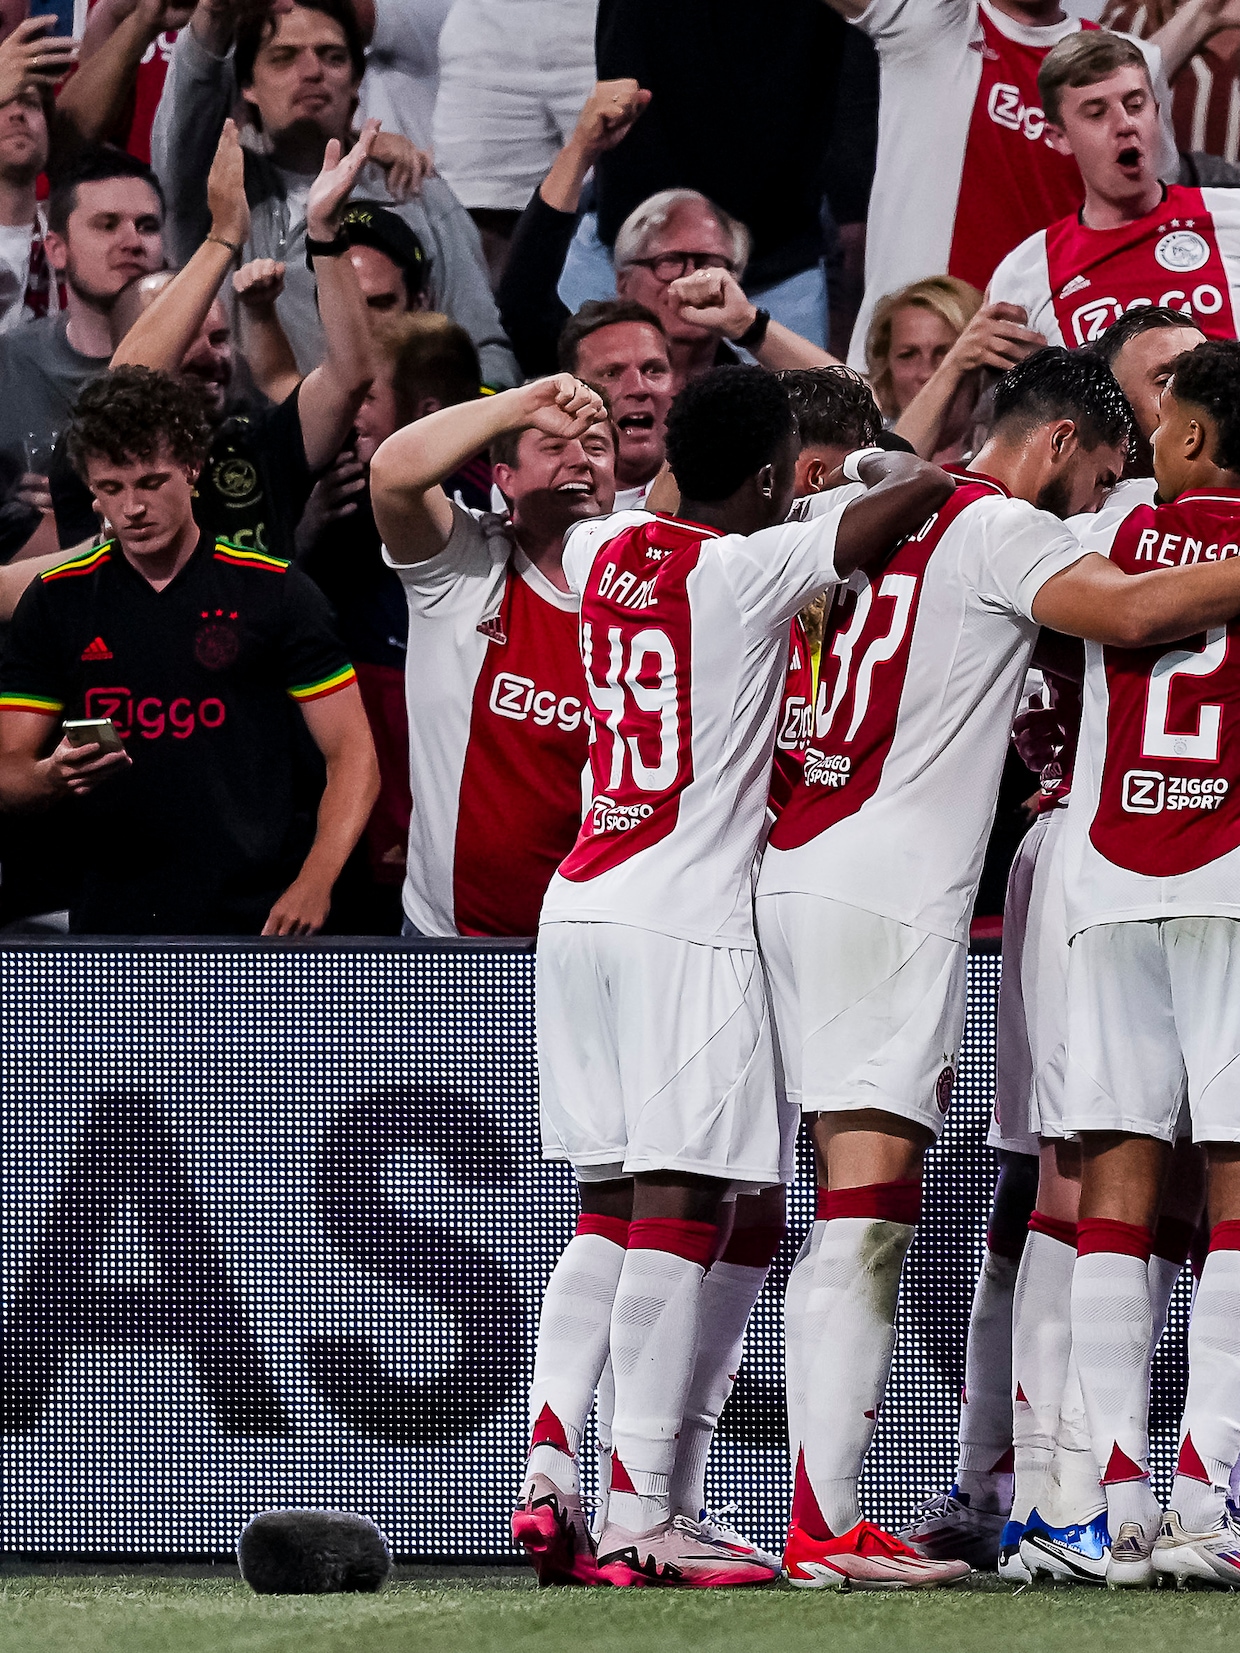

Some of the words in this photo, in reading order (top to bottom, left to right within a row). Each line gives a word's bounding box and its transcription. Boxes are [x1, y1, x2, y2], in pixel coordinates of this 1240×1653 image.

[816, 568, 917, 742] 37
[85, 687, 226, 739] Ziggo
[583, 622, 678, 791] 49
[1142, 624, 1227, 761] 2
[1166, 794, 1225, 811] SPORT
[1167, 777, 1229, 795] ZIGGO
[606, 815, 642, 832] SPOR
